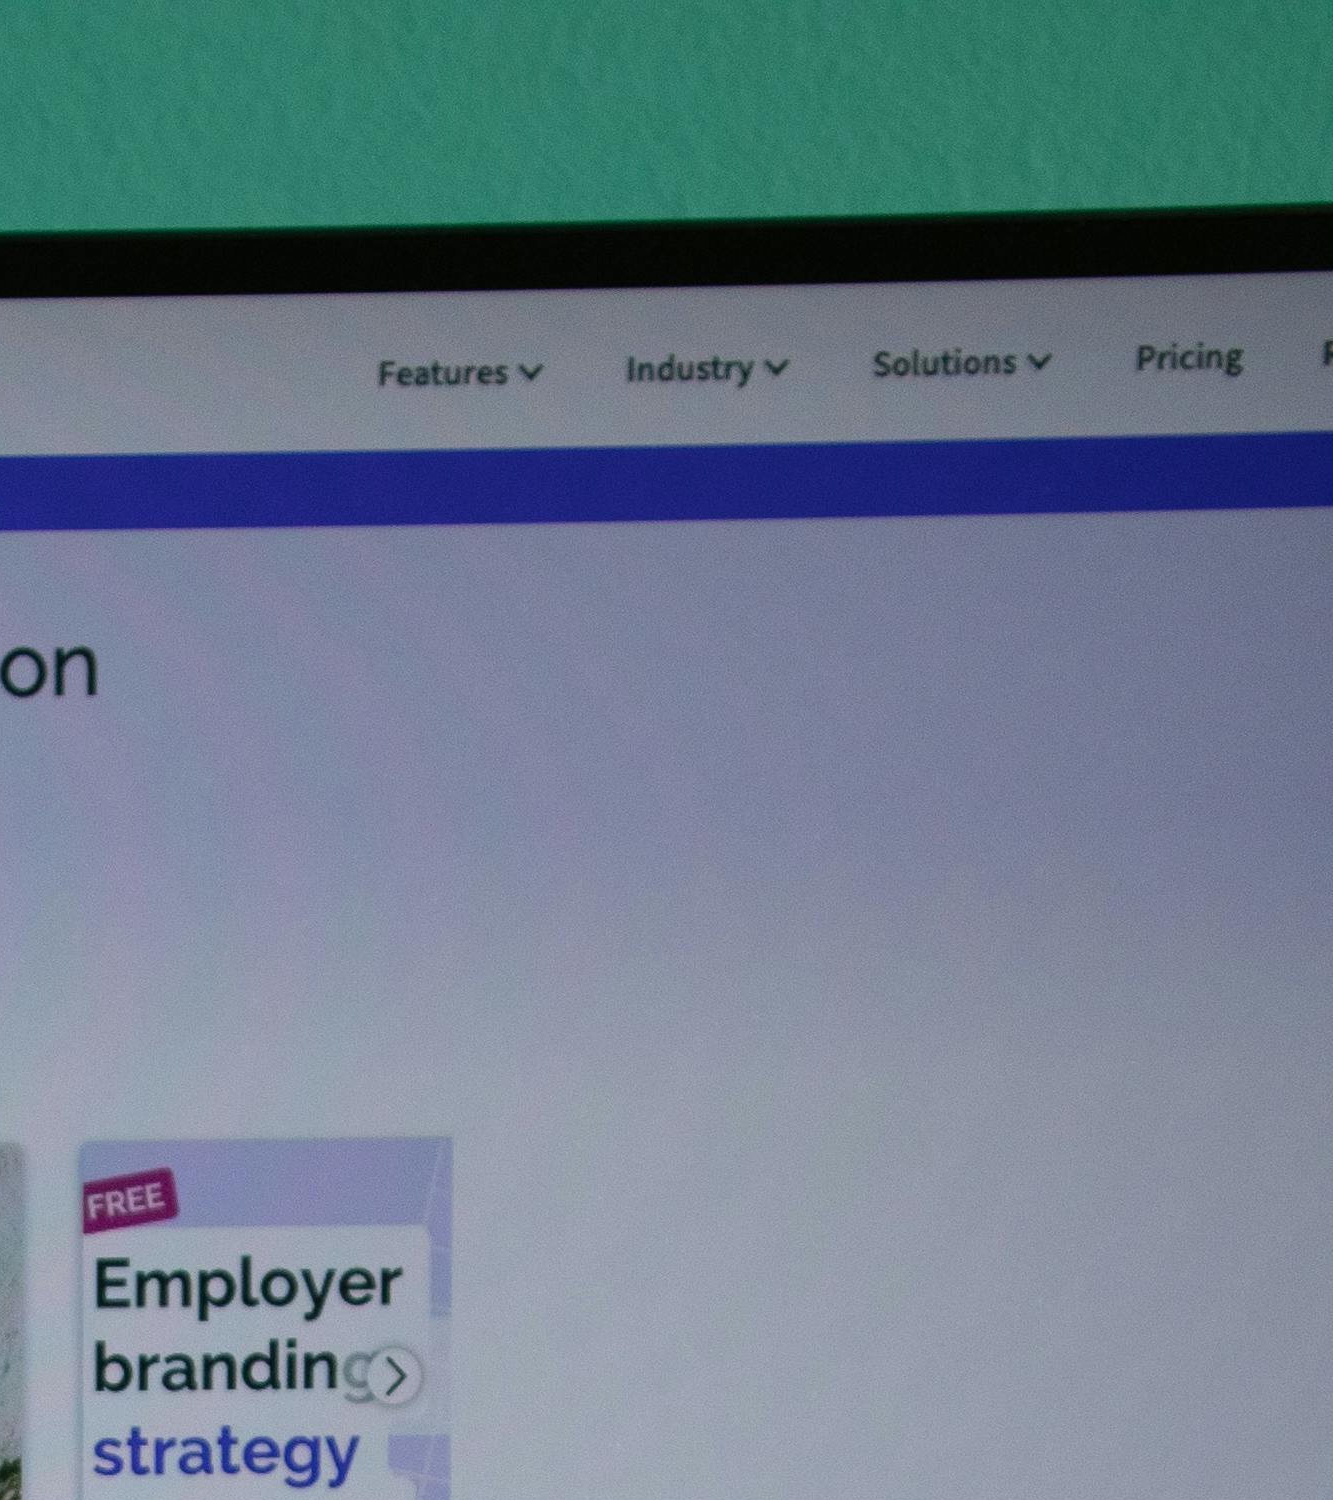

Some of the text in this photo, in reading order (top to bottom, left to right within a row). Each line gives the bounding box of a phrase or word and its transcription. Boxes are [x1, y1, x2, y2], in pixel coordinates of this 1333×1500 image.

[378, 359, 509, 388] Features
[626, 353, 755, 390] Industry
[872, 347, 1018, 378] Solutions
[1135, 341, 1244, 378] Pricing
[86, 1181, 166, 1220] FREE
[95, 1255, 403, 1322] Employer
[93, 1424, 360, 1490] strategy
